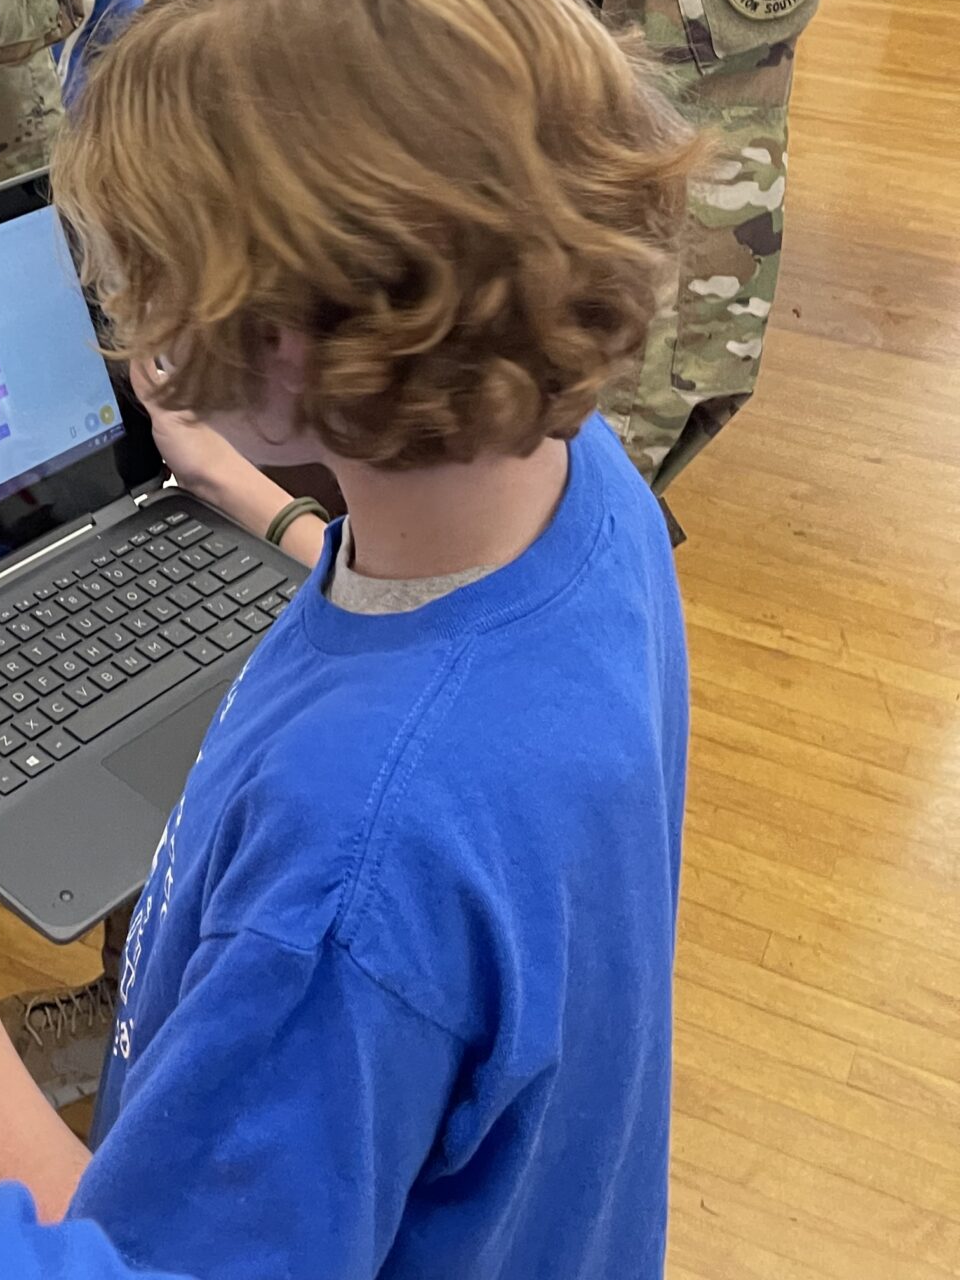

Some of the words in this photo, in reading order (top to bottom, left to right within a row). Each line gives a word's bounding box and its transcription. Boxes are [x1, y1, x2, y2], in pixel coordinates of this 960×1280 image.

[7, 662, 19, 671] R
[32, 647, 42, 656] T
[56, 633, 67, 641] Y
[80, 619, 92, 627] U
[148, 579, 157, 588] P
[0, 735, 13, 746] Z
[25, 719, 39, 729] X
[52, 703, 64, 713] C
[75, 687, 87, 697] V
[101, 672, 113, 682] B
[125, 656, 138, 666] N
[148, 642, 162, 653] M
[12, 692, 25, 702] D
[38, 676, 50, 686] F
[63, 662, 76, 670] G
[87, 647, 100, 657] H
